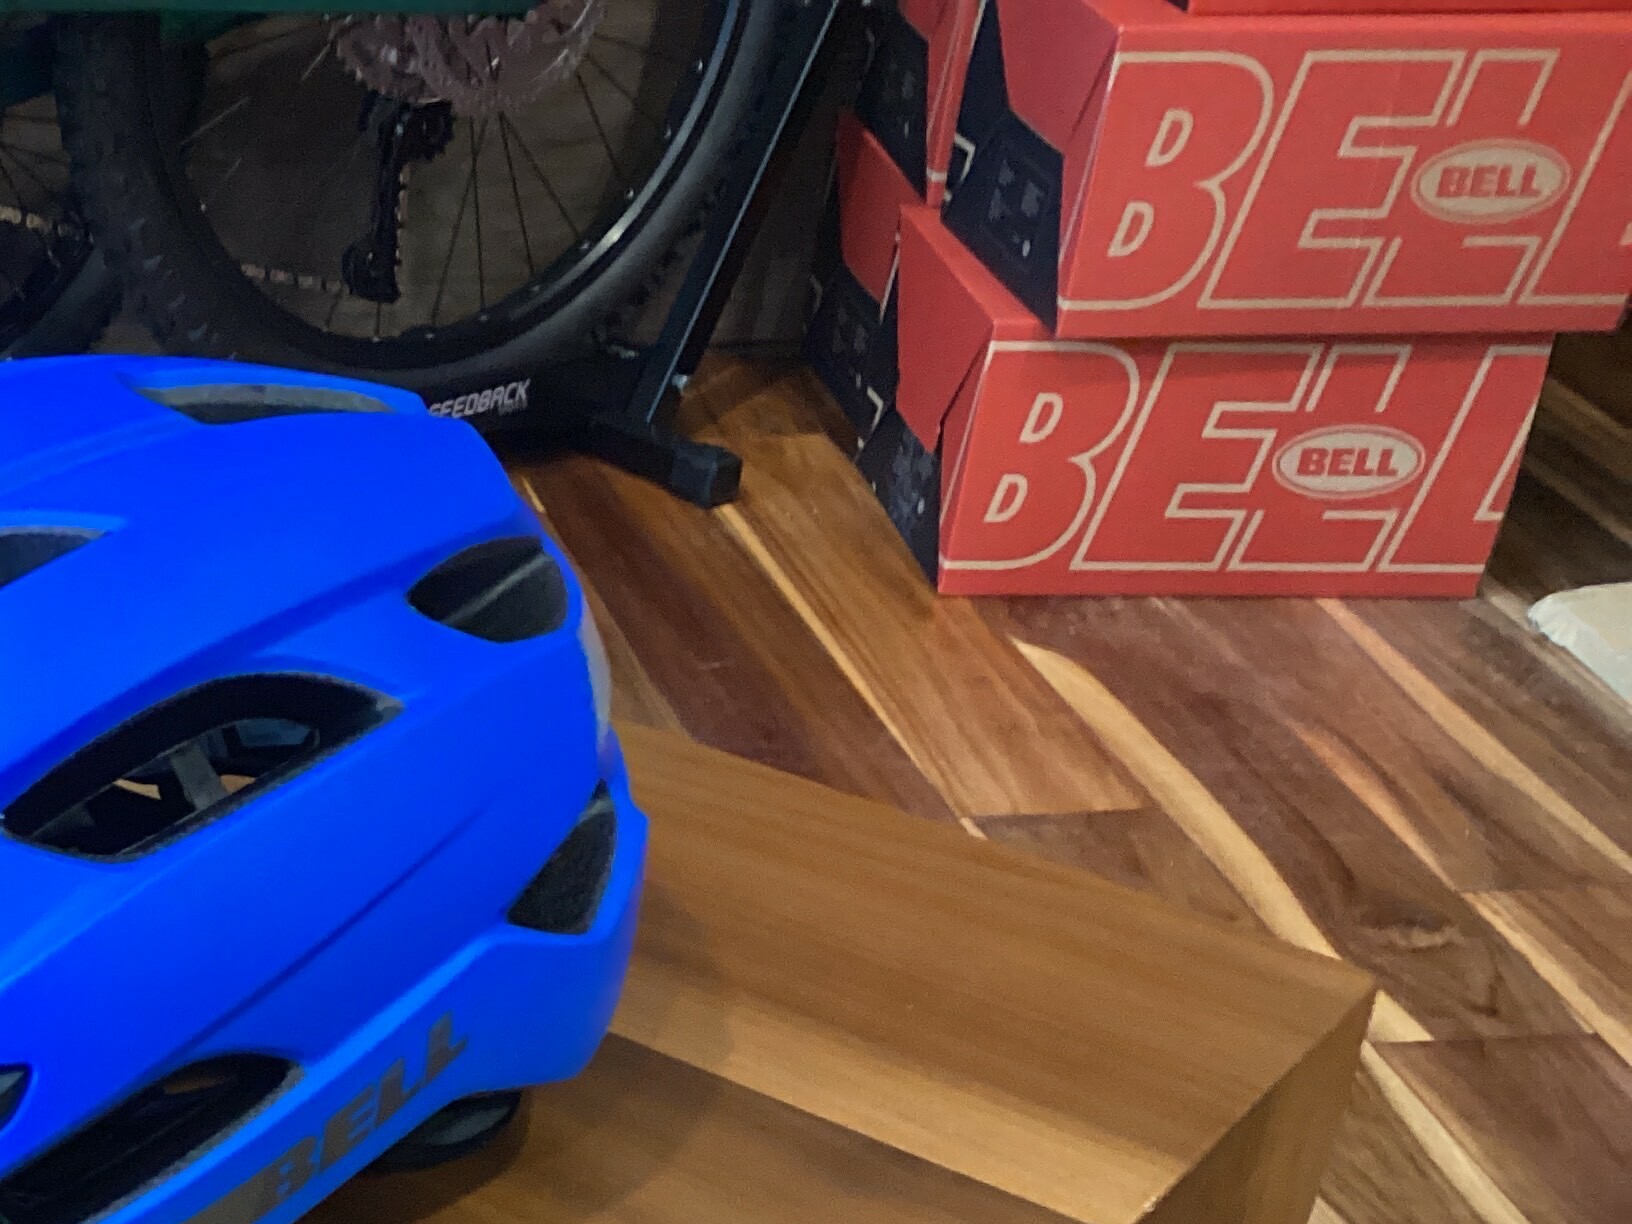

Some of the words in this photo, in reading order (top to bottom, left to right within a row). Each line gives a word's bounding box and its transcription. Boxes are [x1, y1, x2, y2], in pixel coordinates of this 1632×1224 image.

[1436, 165, 1541, 198] BELL
[1296, 447, 1399, 477] BELL
[258, 1011, 468, 1216] BELL
